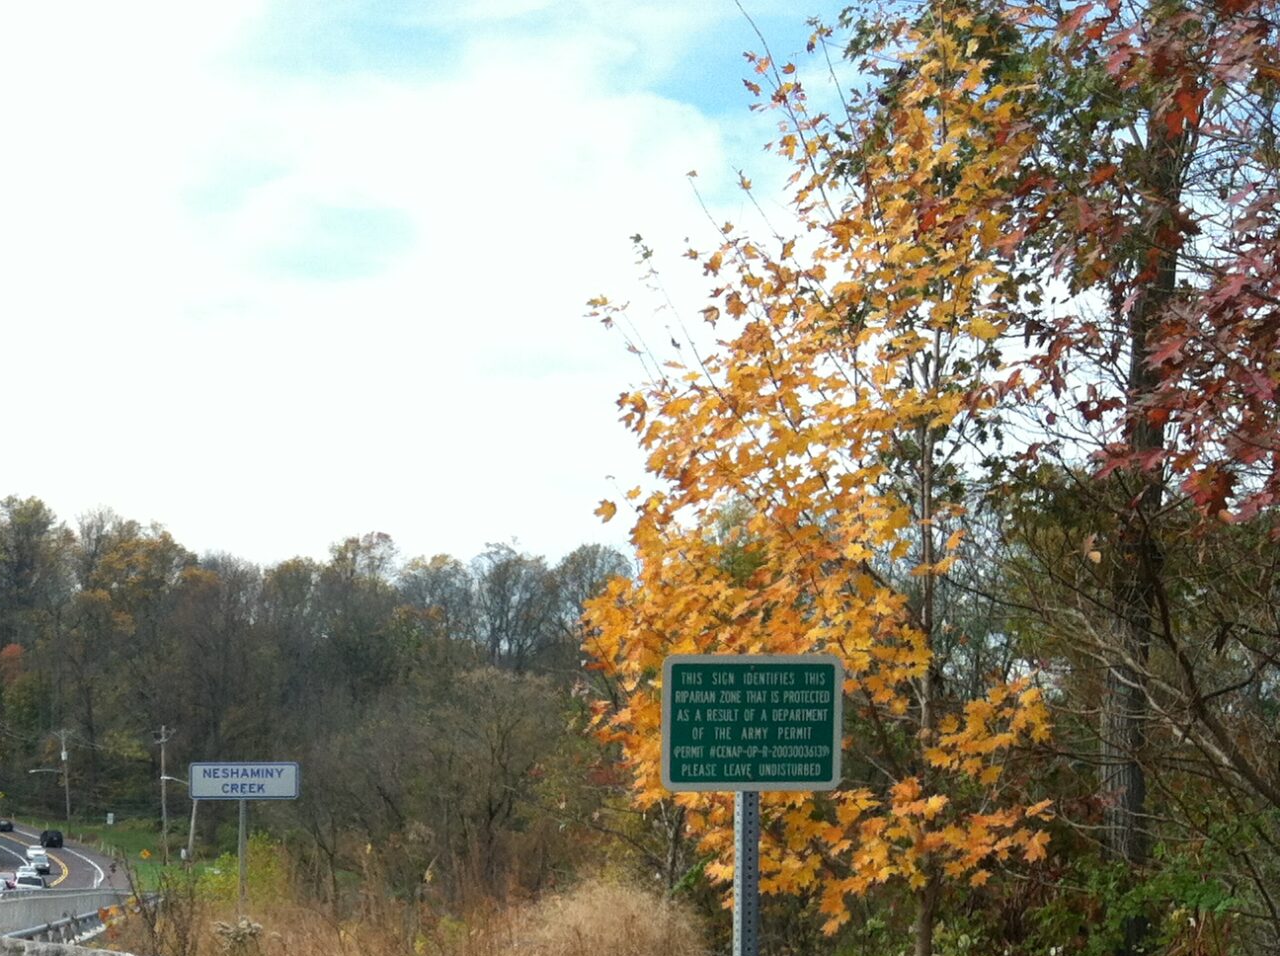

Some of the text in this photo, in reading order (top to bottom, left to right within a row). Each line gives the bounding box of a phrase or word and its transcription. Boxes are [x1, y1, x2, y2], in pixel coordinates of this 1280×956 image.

[682, 672, 826, 685] THIS SIGN IDENTIFIES THIS
[675, 691, 830, 703] RIPARIAN ZONE THAT IS PROTECTED
[677, 709, 828, 721] AS A RESULT OF A DEPARTMENT
[692, 727, 812, 740] OF THE ARMY PERMIT
[203, 768, 284, 778] NESHAMINY
[682, 764, 821, 777] PLEASE LEAVE UNDISTURBED
[222, 784, 265, 793] CREEK
